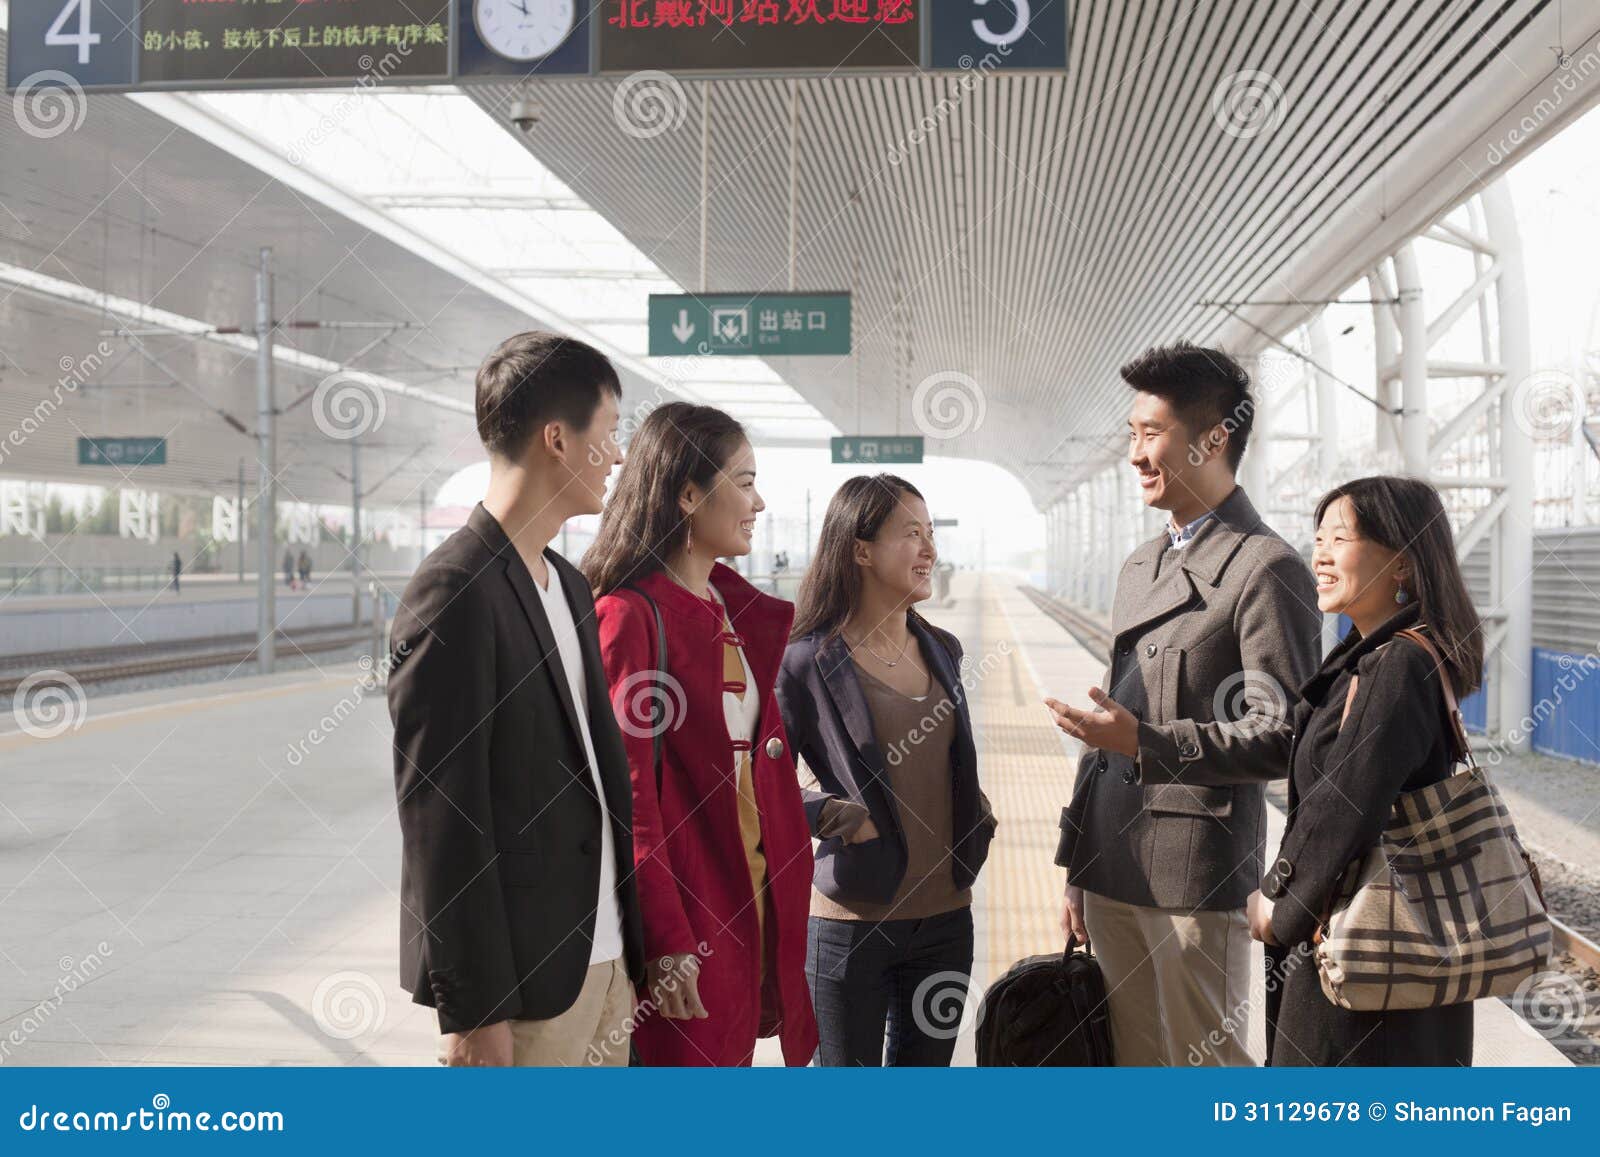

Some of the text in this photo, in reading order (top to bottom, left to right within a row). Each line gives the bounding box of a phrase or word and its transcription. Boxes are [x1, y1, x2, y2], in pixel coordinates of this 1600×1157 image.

[45, 0, 101, 64] 4
[144, 23, 448, 50] 的小孩，按先下后上的秩序有序乘
[759, 309, 826, 331] 出站口
